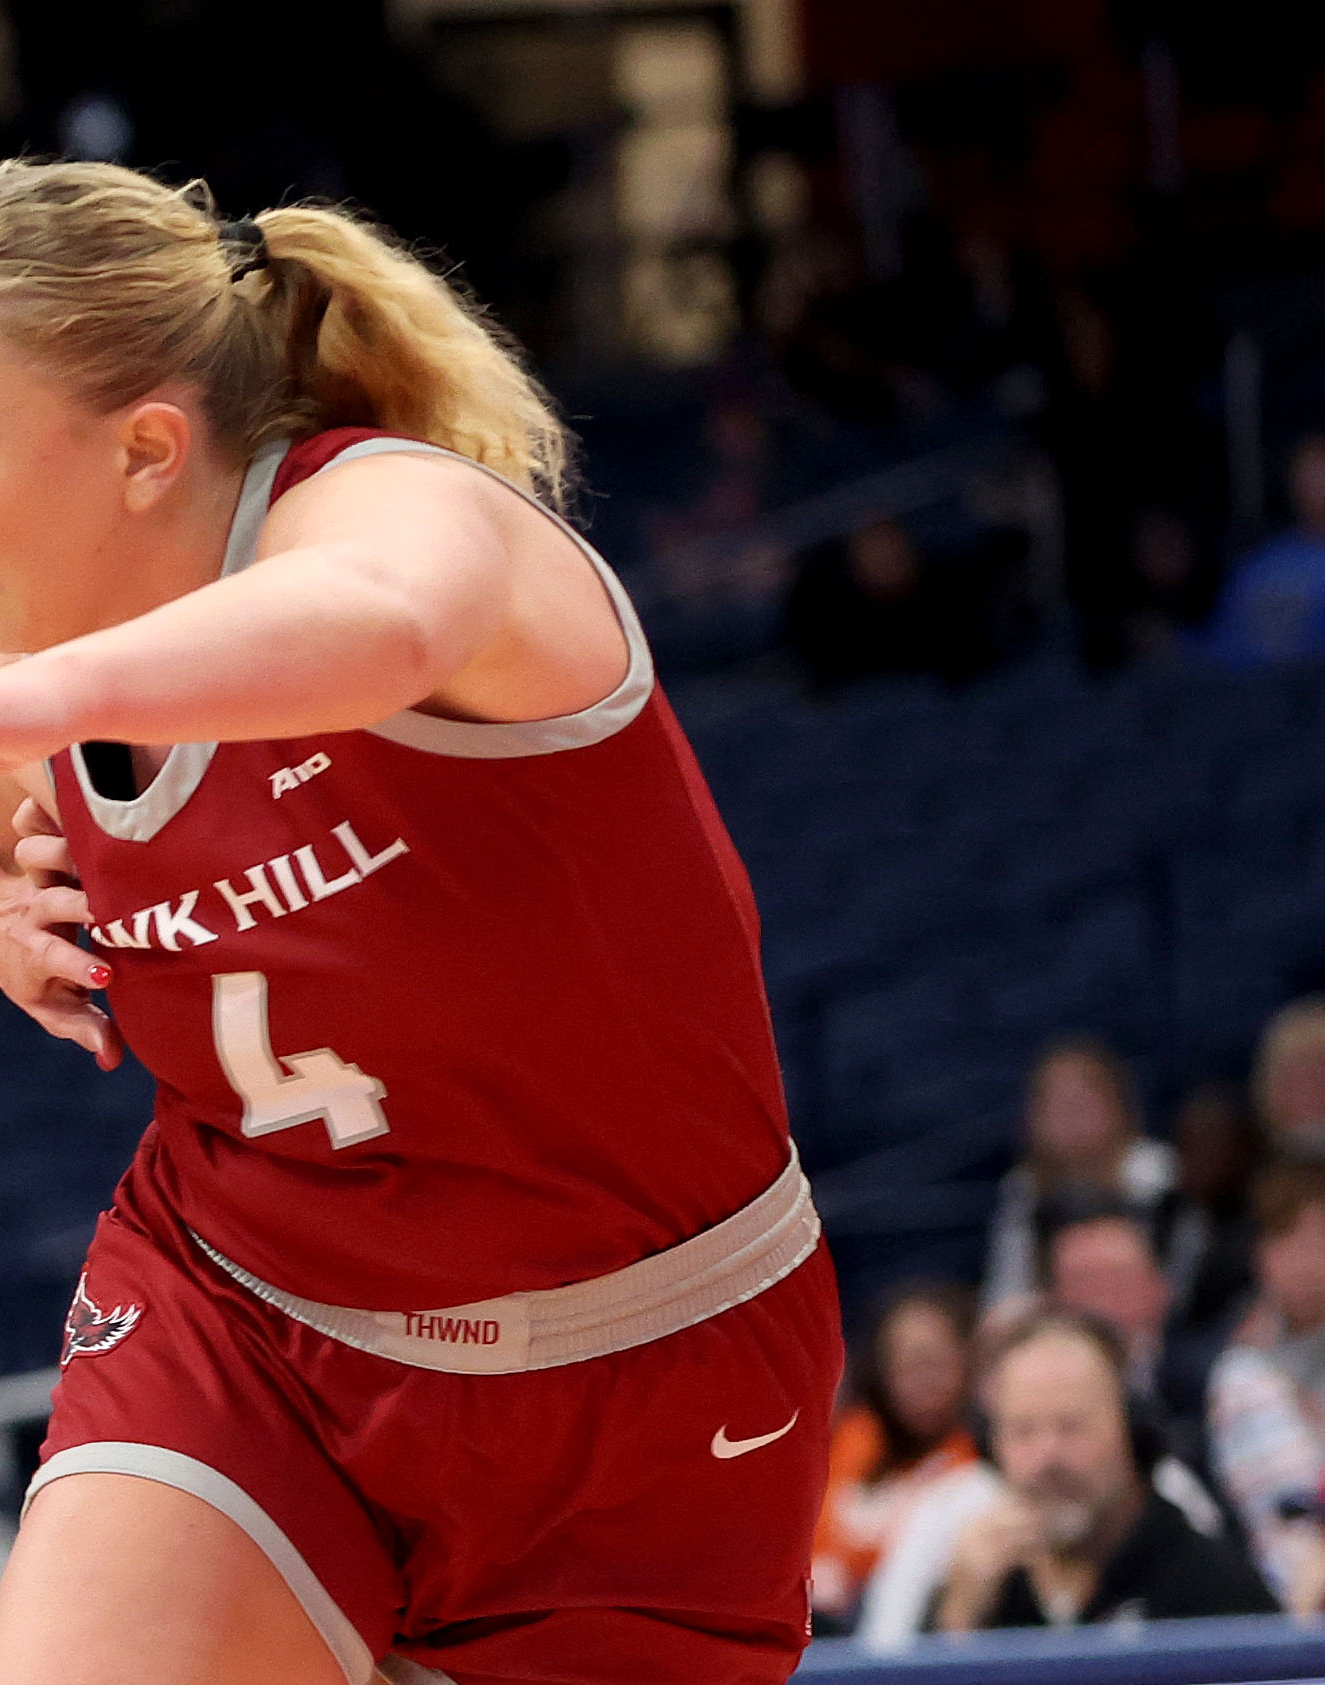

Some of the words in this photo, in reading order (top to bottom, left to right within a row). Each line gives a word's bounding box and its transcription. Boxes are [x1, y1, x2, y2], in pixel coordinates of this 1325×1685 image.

[213, 820, 411, 932] HILL
[211, 970, 390, 1150] 4
[401, 1310, 500, 1346] THWND
